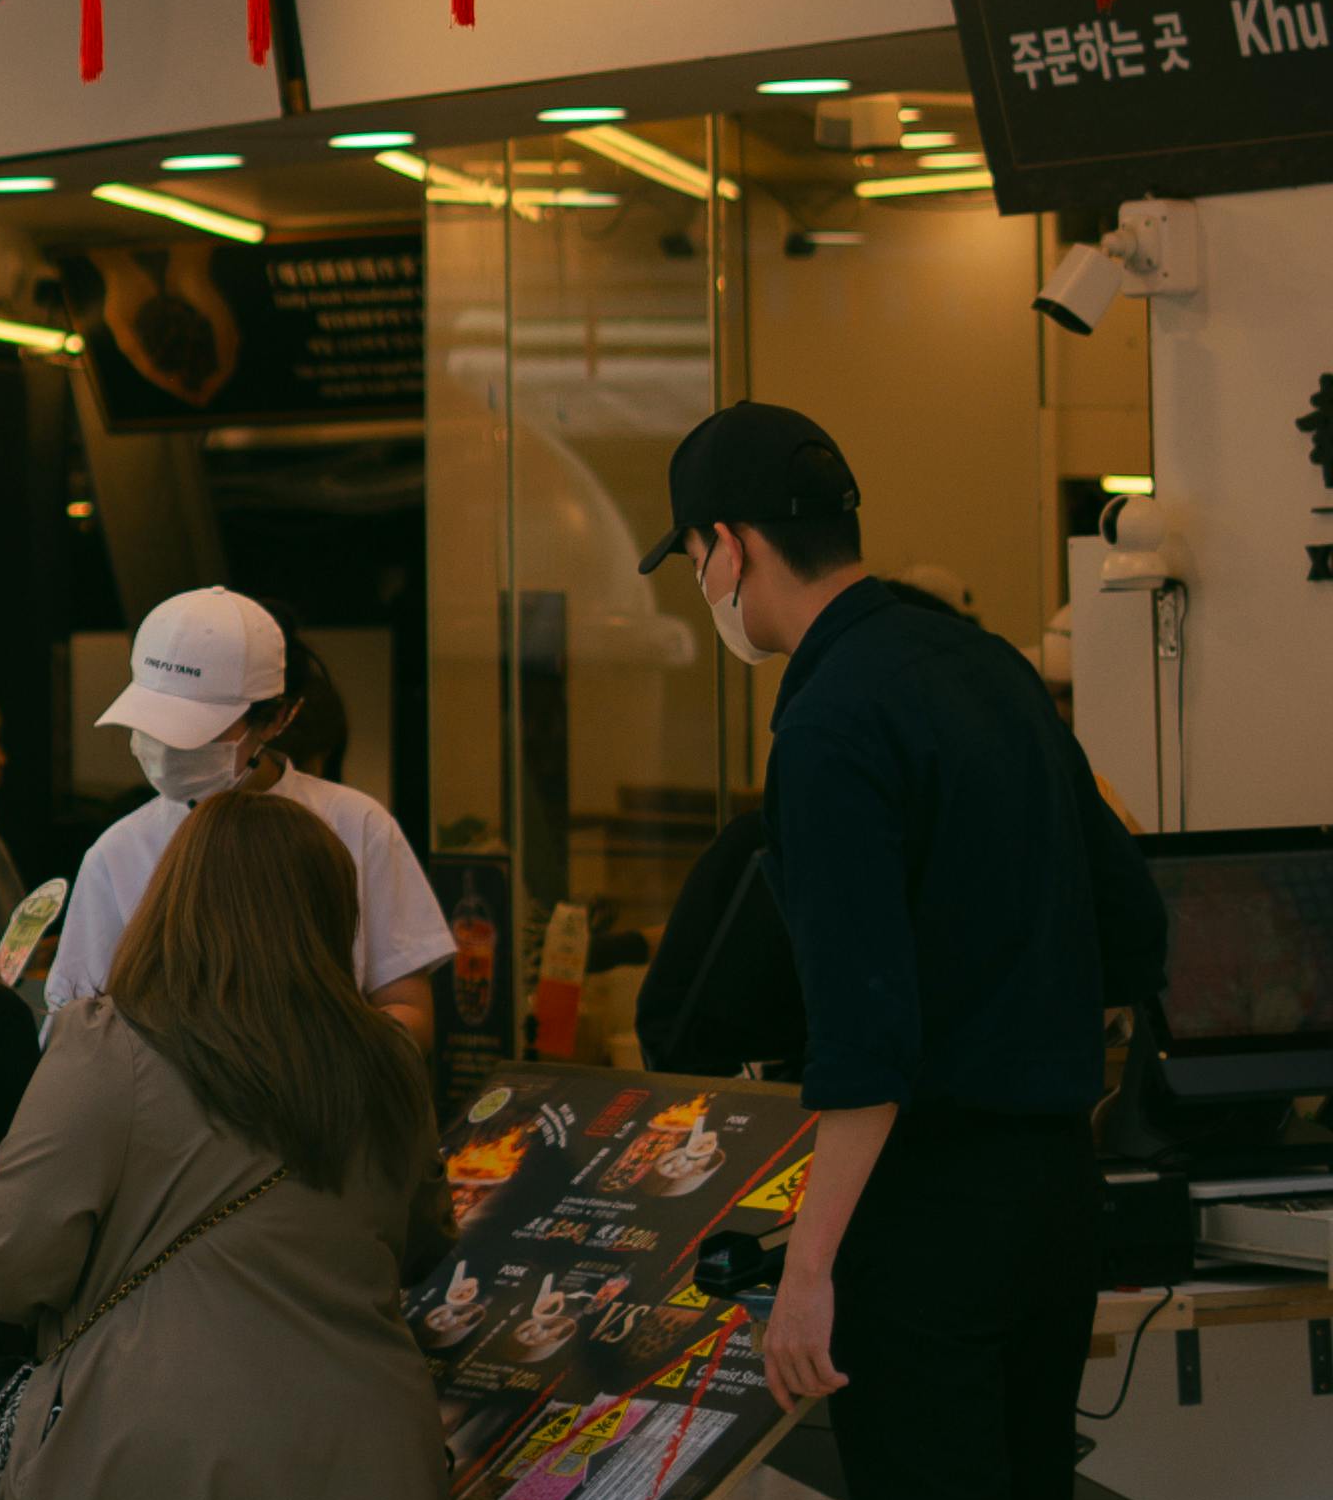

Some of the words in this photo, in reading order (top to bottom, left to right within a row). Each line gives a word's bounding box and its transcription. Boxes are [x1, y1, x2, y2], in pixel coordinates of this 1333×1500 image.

[1010, 19, 1146, 90] 주문하는
[1153, 12, 1190, 72] 곳
[590, 1302, 651, 1343] VS
